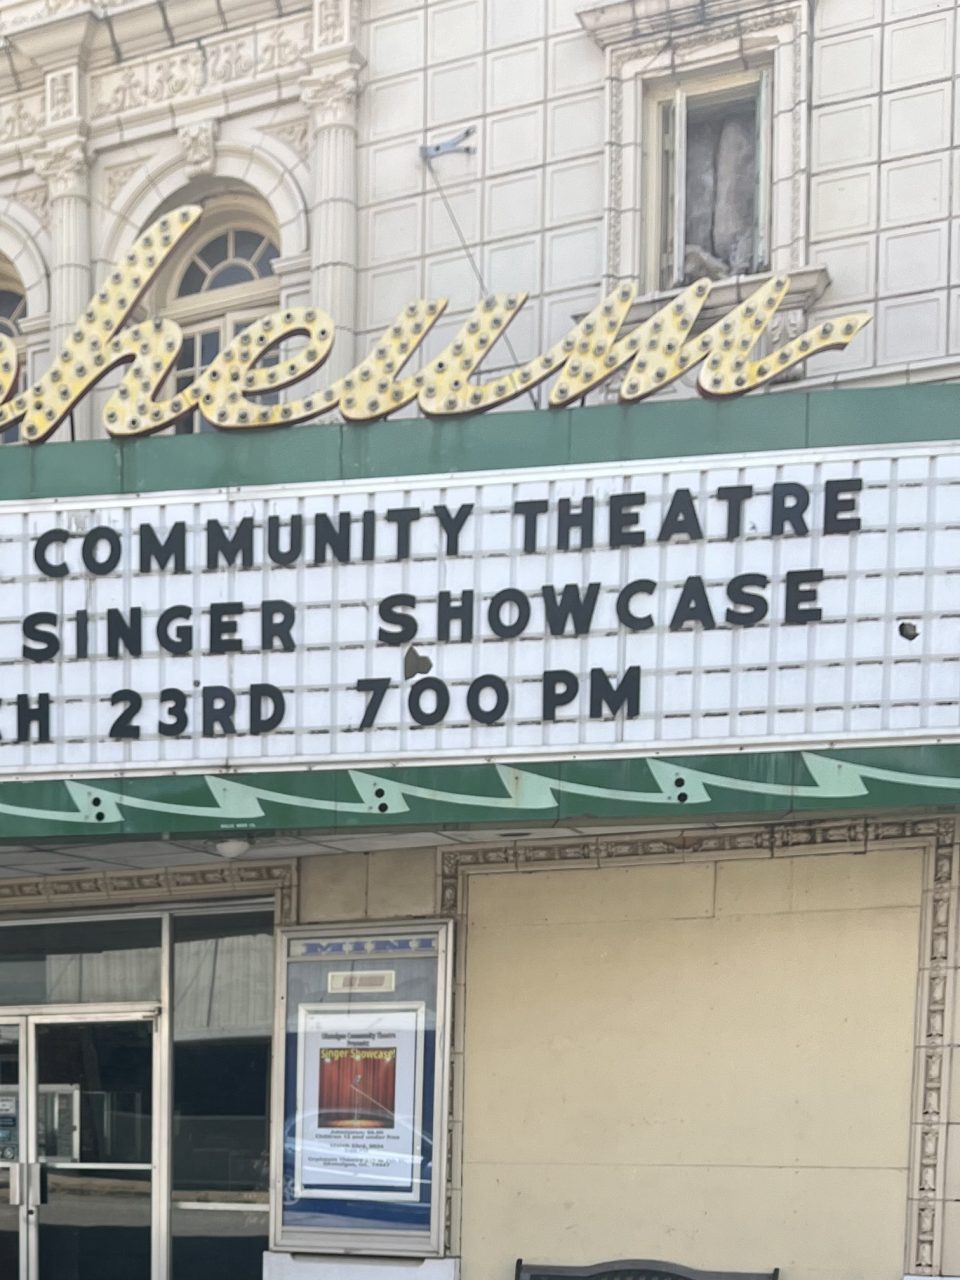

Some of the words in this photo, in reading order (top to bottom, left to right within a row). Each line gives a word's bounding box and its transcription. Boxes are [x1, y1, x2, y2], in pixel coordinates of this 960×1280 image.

[33, 503, 474, 577] COMMUNITY
[512, 478, 863, 554] THEATRE
[21, 600, 297, 663] SINGER
[377, 569, 824, 646] SHOWCASE
[109, 683, 286, 738] 23RD
[543, 666, 641, 721] PM
